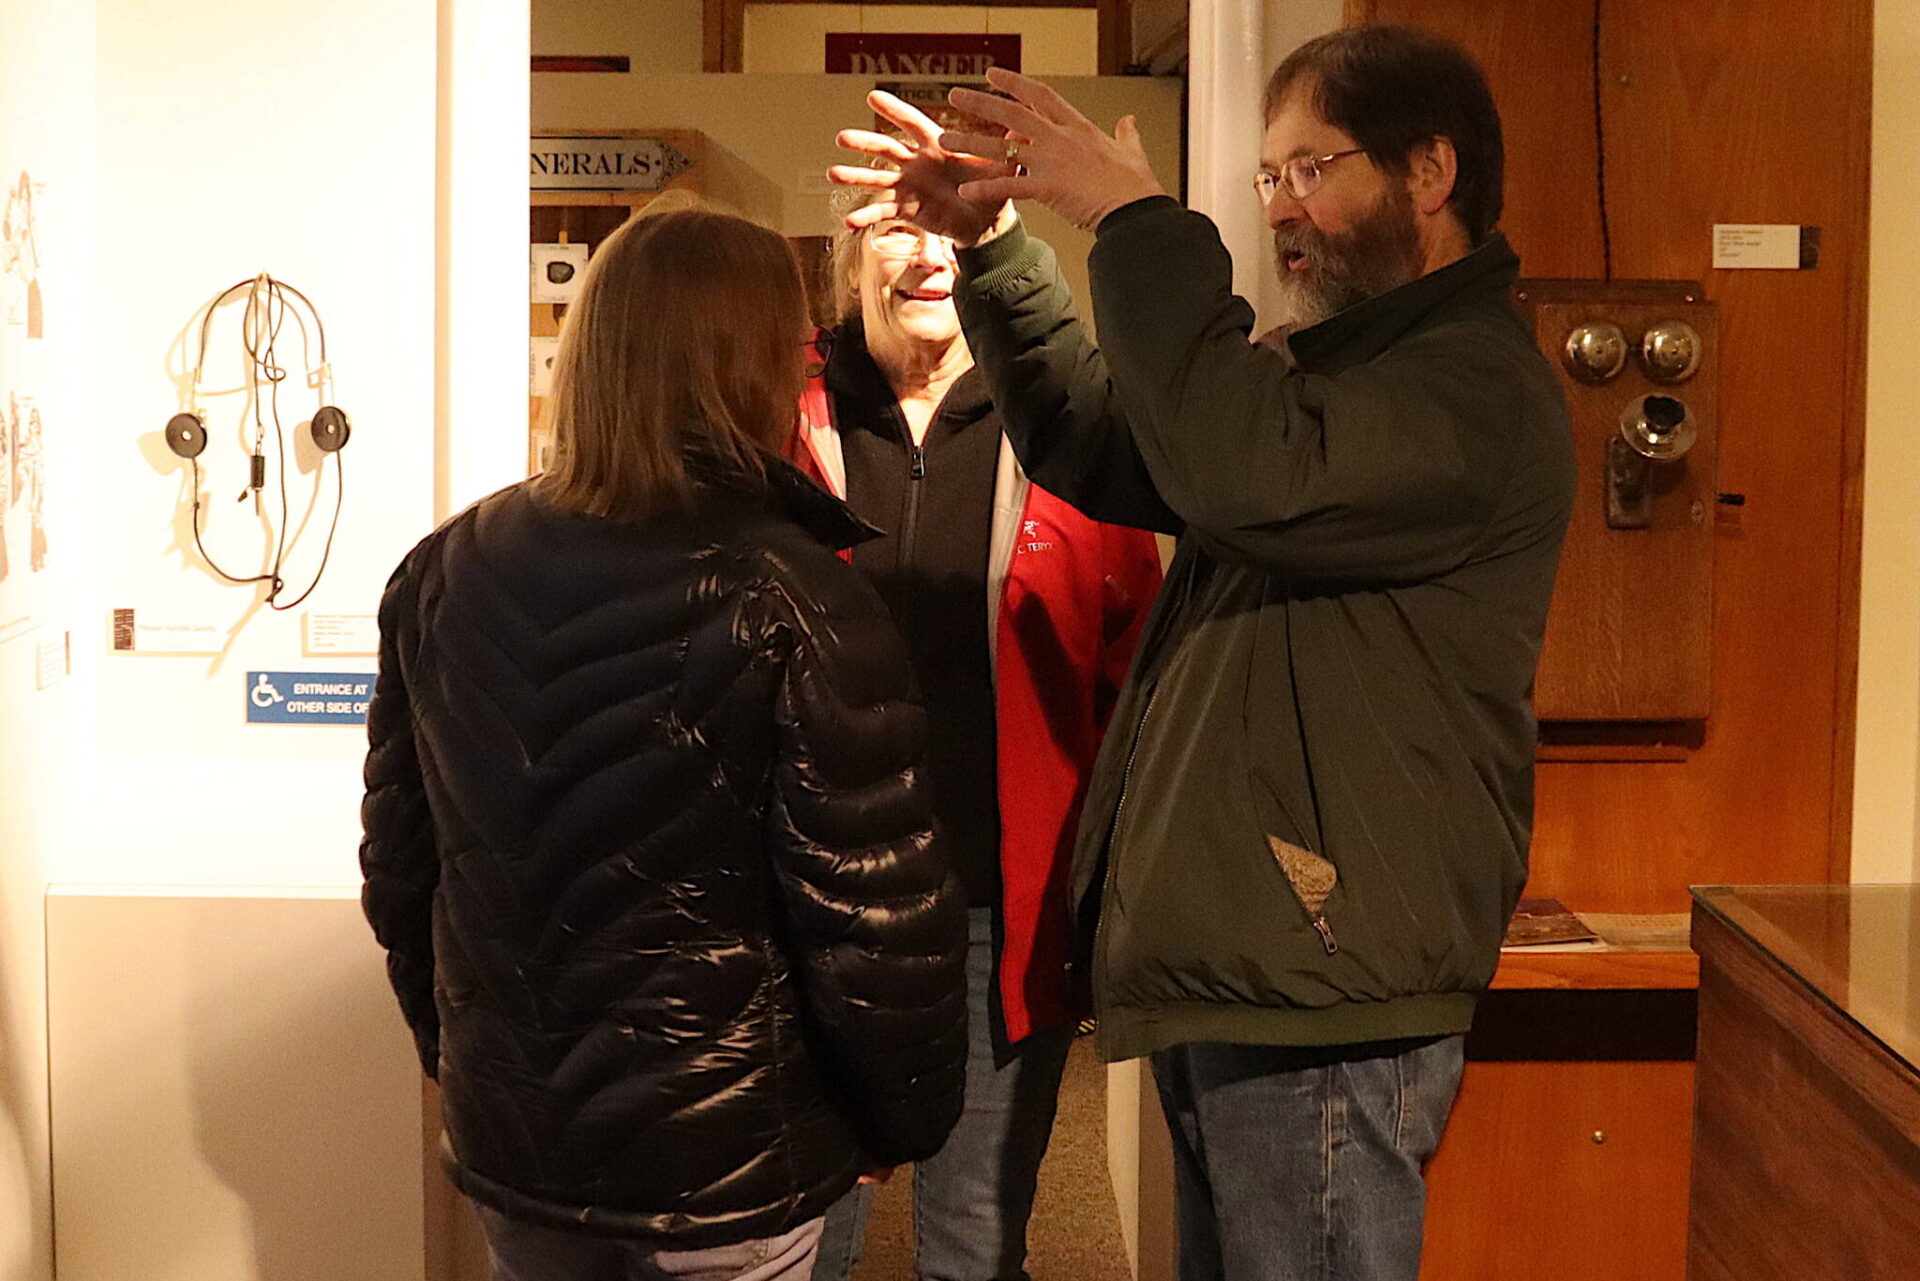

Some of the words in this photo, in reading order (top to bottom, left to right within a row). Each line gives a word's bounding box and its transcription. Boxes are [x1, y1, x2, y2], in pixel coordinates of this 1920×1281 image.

[850, 52, 995, 74] DANGER
[531, 152, 651, 175] NERALS
[293, 683, 352, 695] ENTRANCE
[353, 684, 369, 695] AT
[286, 701, 325, 713] OTHER
[326, 702, 352, 713] SIDE
[353, 702, 370, 714] OF
